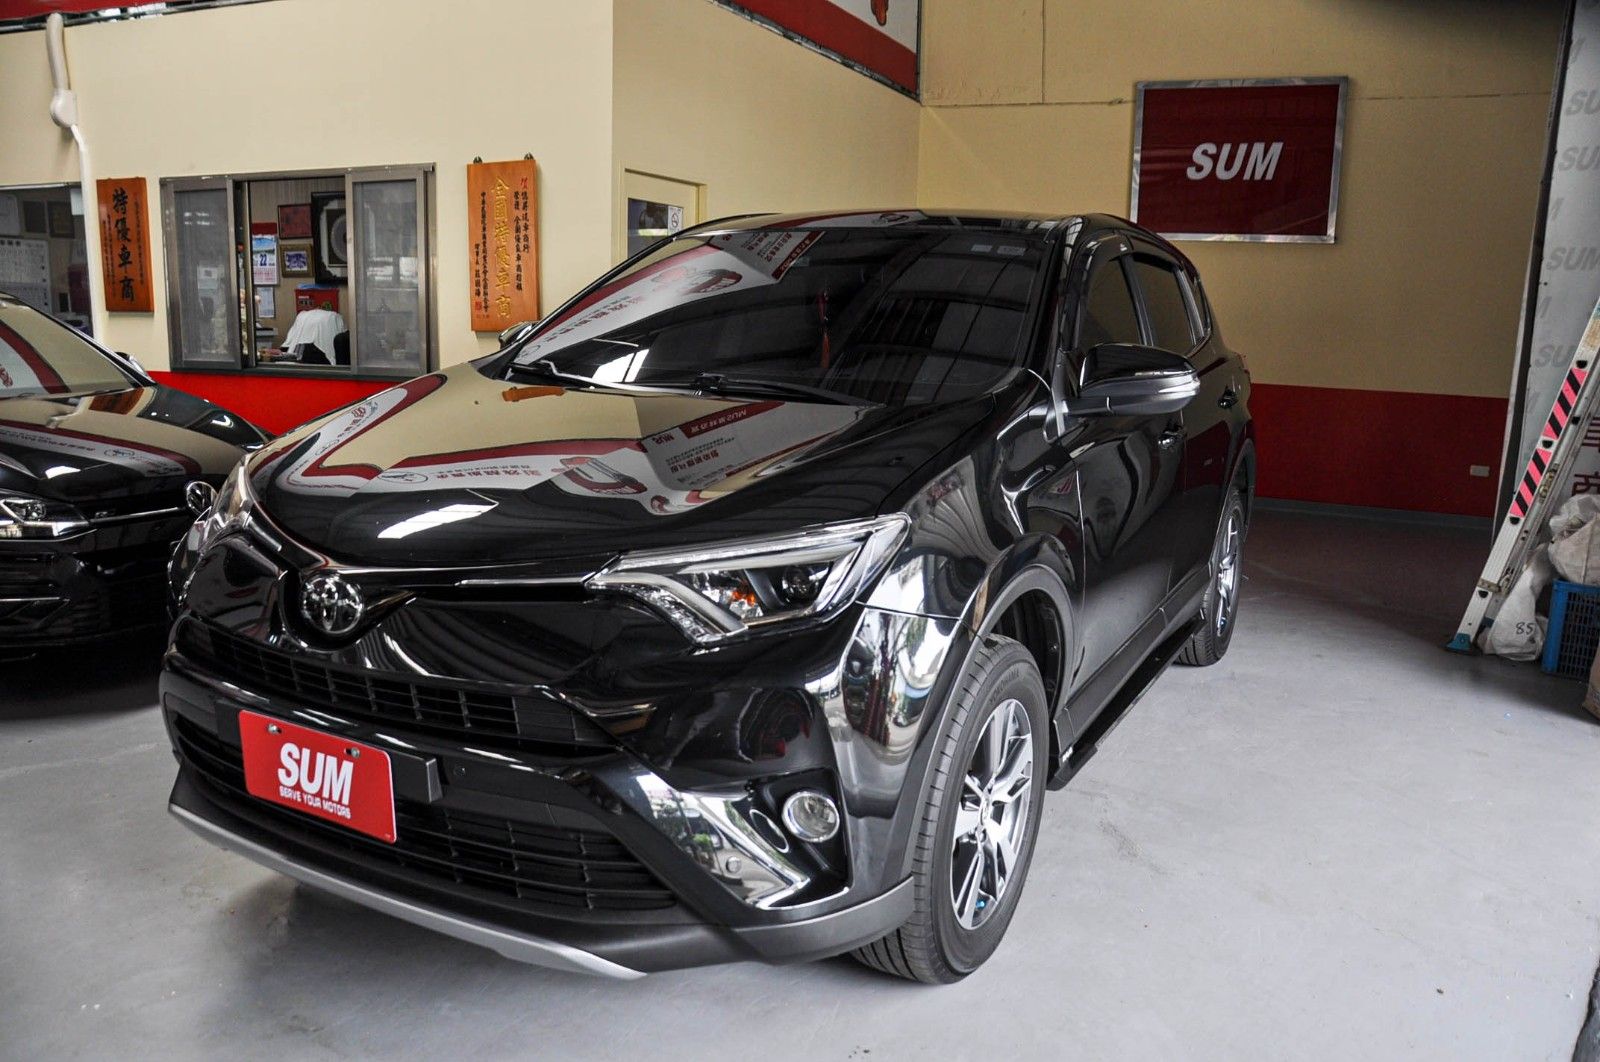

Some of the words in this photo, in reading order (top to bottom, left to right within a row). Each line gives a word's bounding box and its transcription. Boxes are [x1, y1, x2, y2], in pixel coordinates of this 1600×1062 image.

[1565, 89, 1600, 116] SU
[1186, 141, 1284, 181] SUM
[1558, 146, 1600, 171] SU
[259, 253, 268, 267] 22
[1534, 344, 1575, 368] SU
[1515, 620, 1535, 636] 85
[278, 742, 354, 805] SUM
[279, 785, 302, 801] SERVE
[302, 793, 322, 808] YOUR
[322, 801, 351, 819] MOTORS
